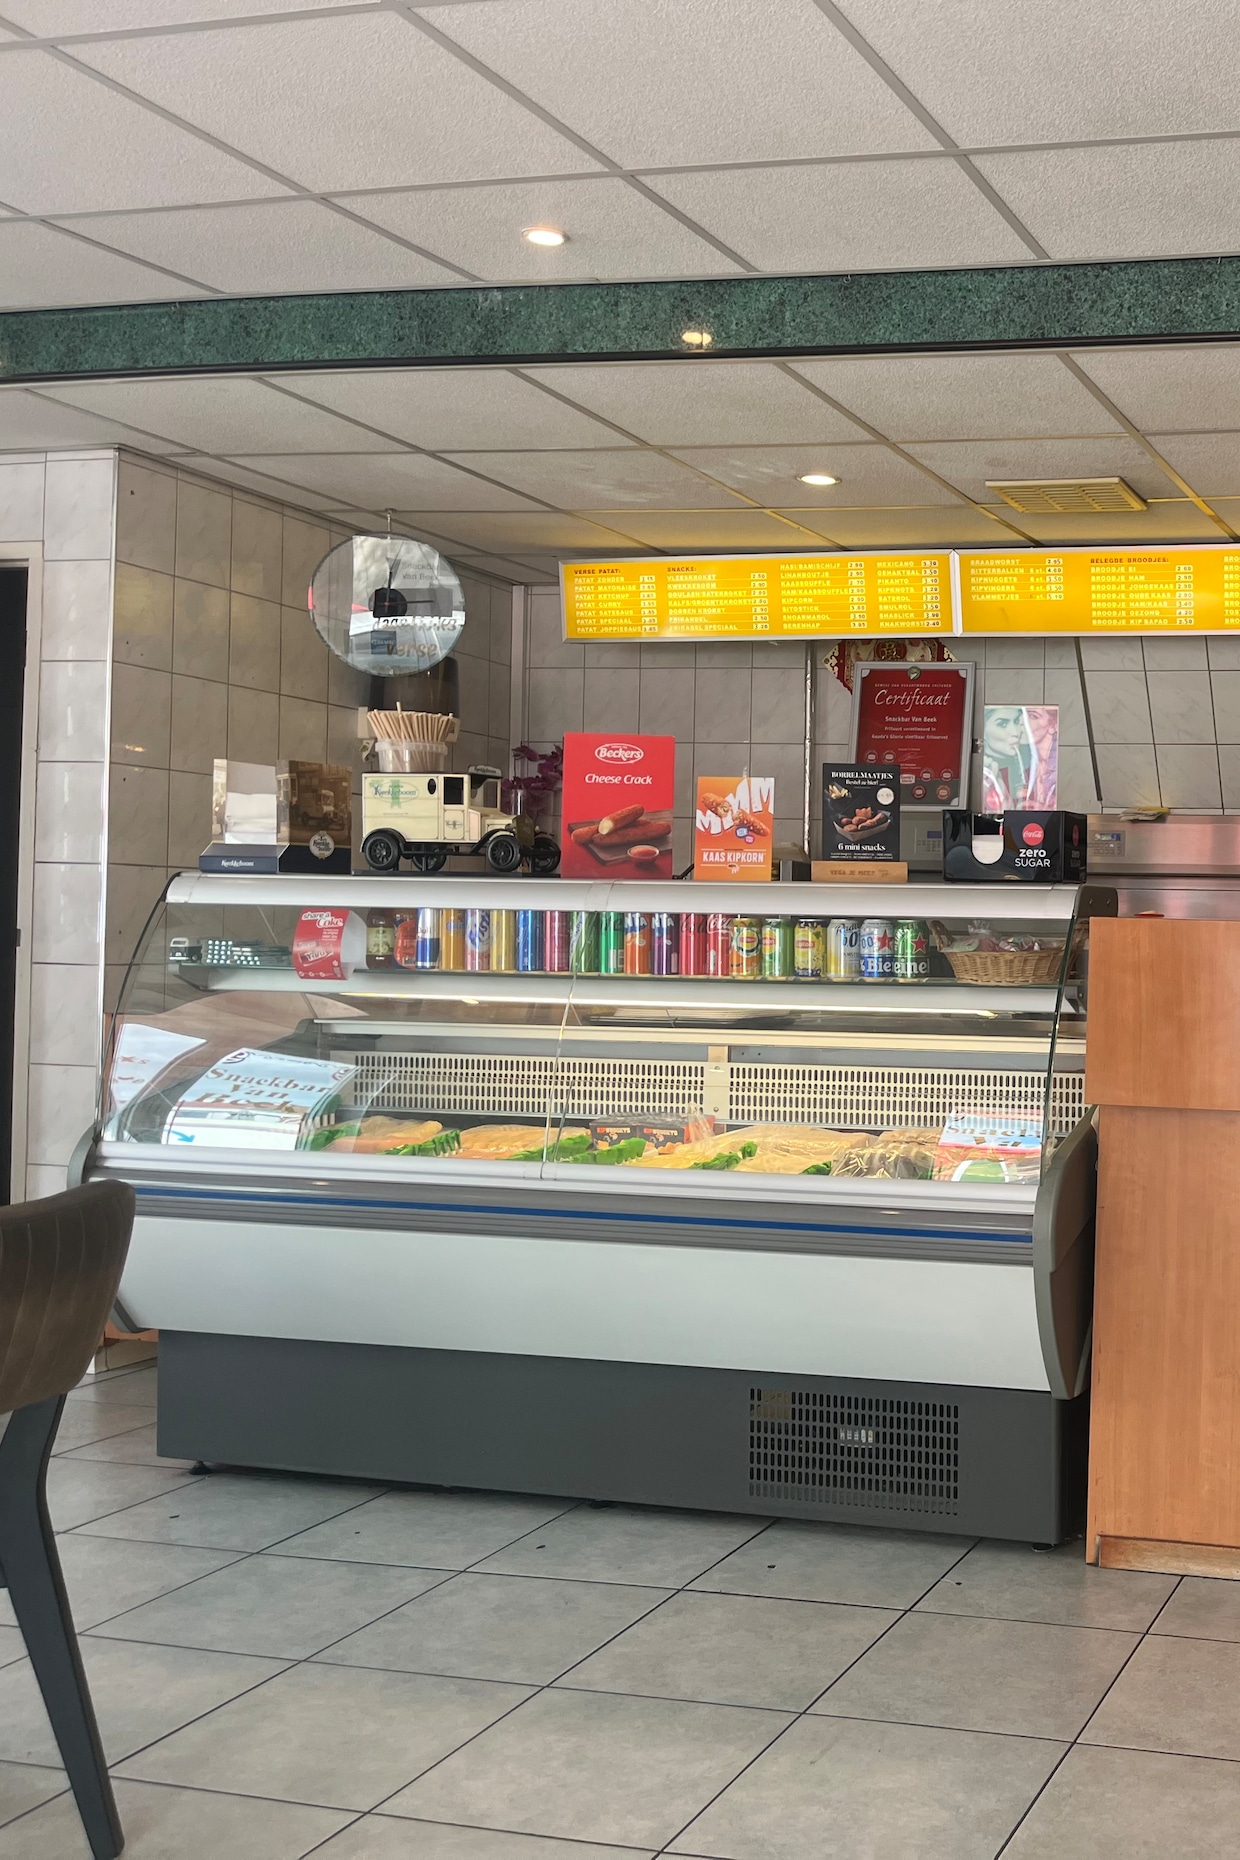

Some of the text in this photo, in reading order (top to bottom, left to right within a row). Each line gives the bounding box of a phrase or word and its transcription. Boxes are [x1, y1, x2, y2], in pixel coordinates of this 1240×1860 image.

[874, 688, 950, 712] Certificaat
[599, 747, 641, 762] Beckers
[585, 773, 653, 785] Cheese Crack
[831, 771, 893, 780] BORRELMAATJES
[845, 843, 860, 851] mini
[703, 852, 764, 863] KAAS KIPKORN
[1019, 849, 1047, 858] zero
[1014, 858, 1051, 867] SUGAR
